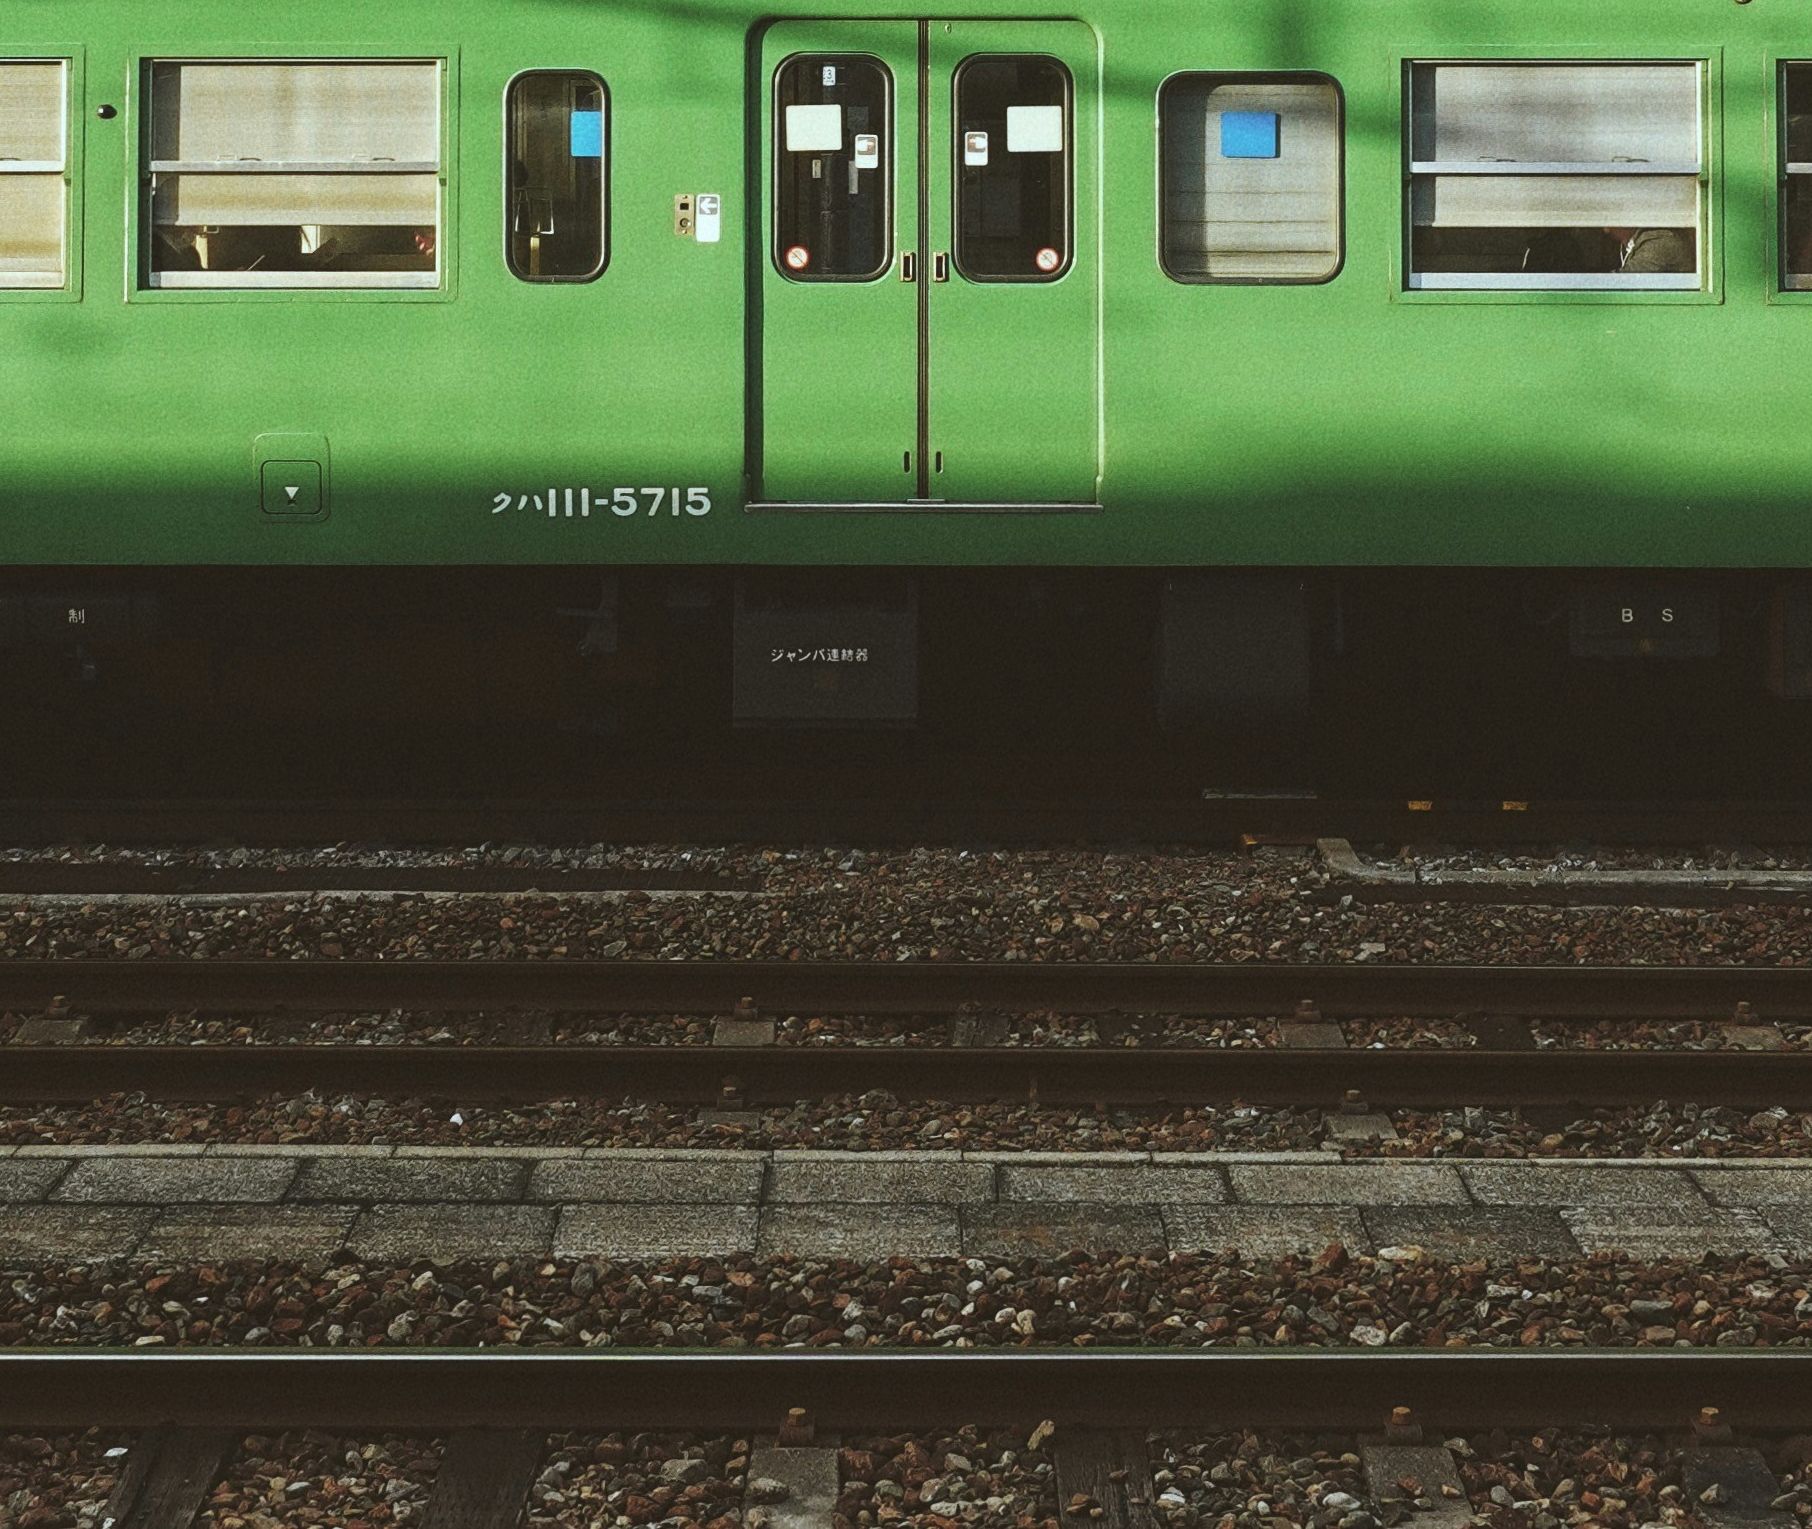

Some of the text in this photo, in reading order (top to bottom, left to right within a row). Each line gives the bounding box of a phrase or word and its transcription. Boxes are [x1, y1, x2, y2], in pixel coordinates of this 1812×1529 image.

[68, 608, 85, 624] 制
[1621, 608, 1674, 622] B S
